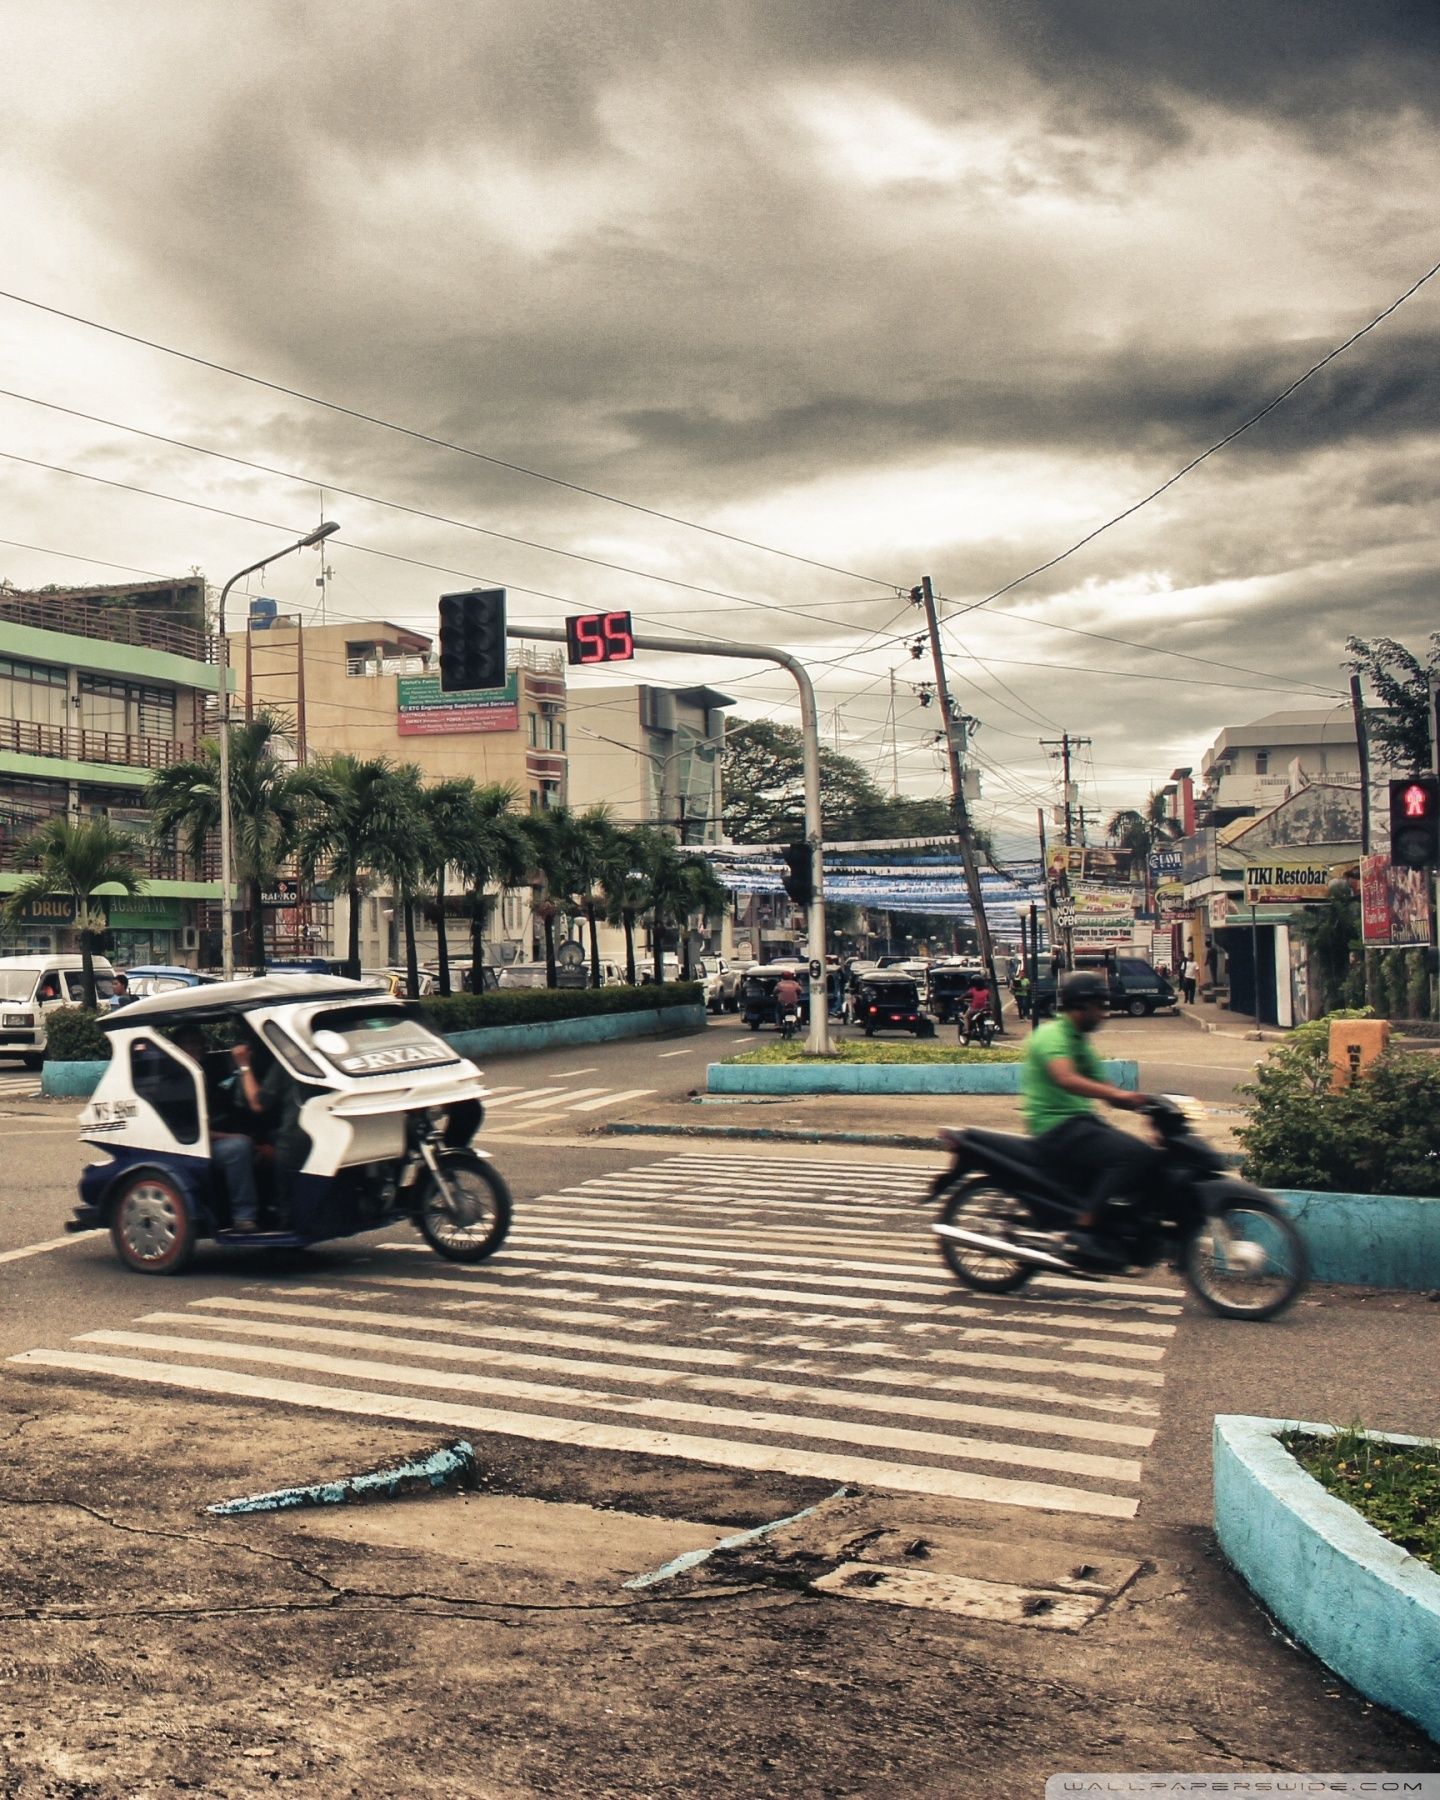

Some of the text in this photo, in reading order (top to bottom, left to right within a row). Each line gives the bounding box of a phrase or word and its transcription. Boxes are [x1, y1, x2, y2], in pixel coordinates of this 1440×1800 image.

[575, 612, 633, 663] 55
[1247, 866, 1328, 885] TIKI Restobar
[32, 900, 72, 917] DRUG
[1056, 905, 1075, 915] NOW
[1057, 915, 1077, 926] OPEN
[1072, 928, 1090, 936] Open
[1099, 928, 1118, 936] Serve
